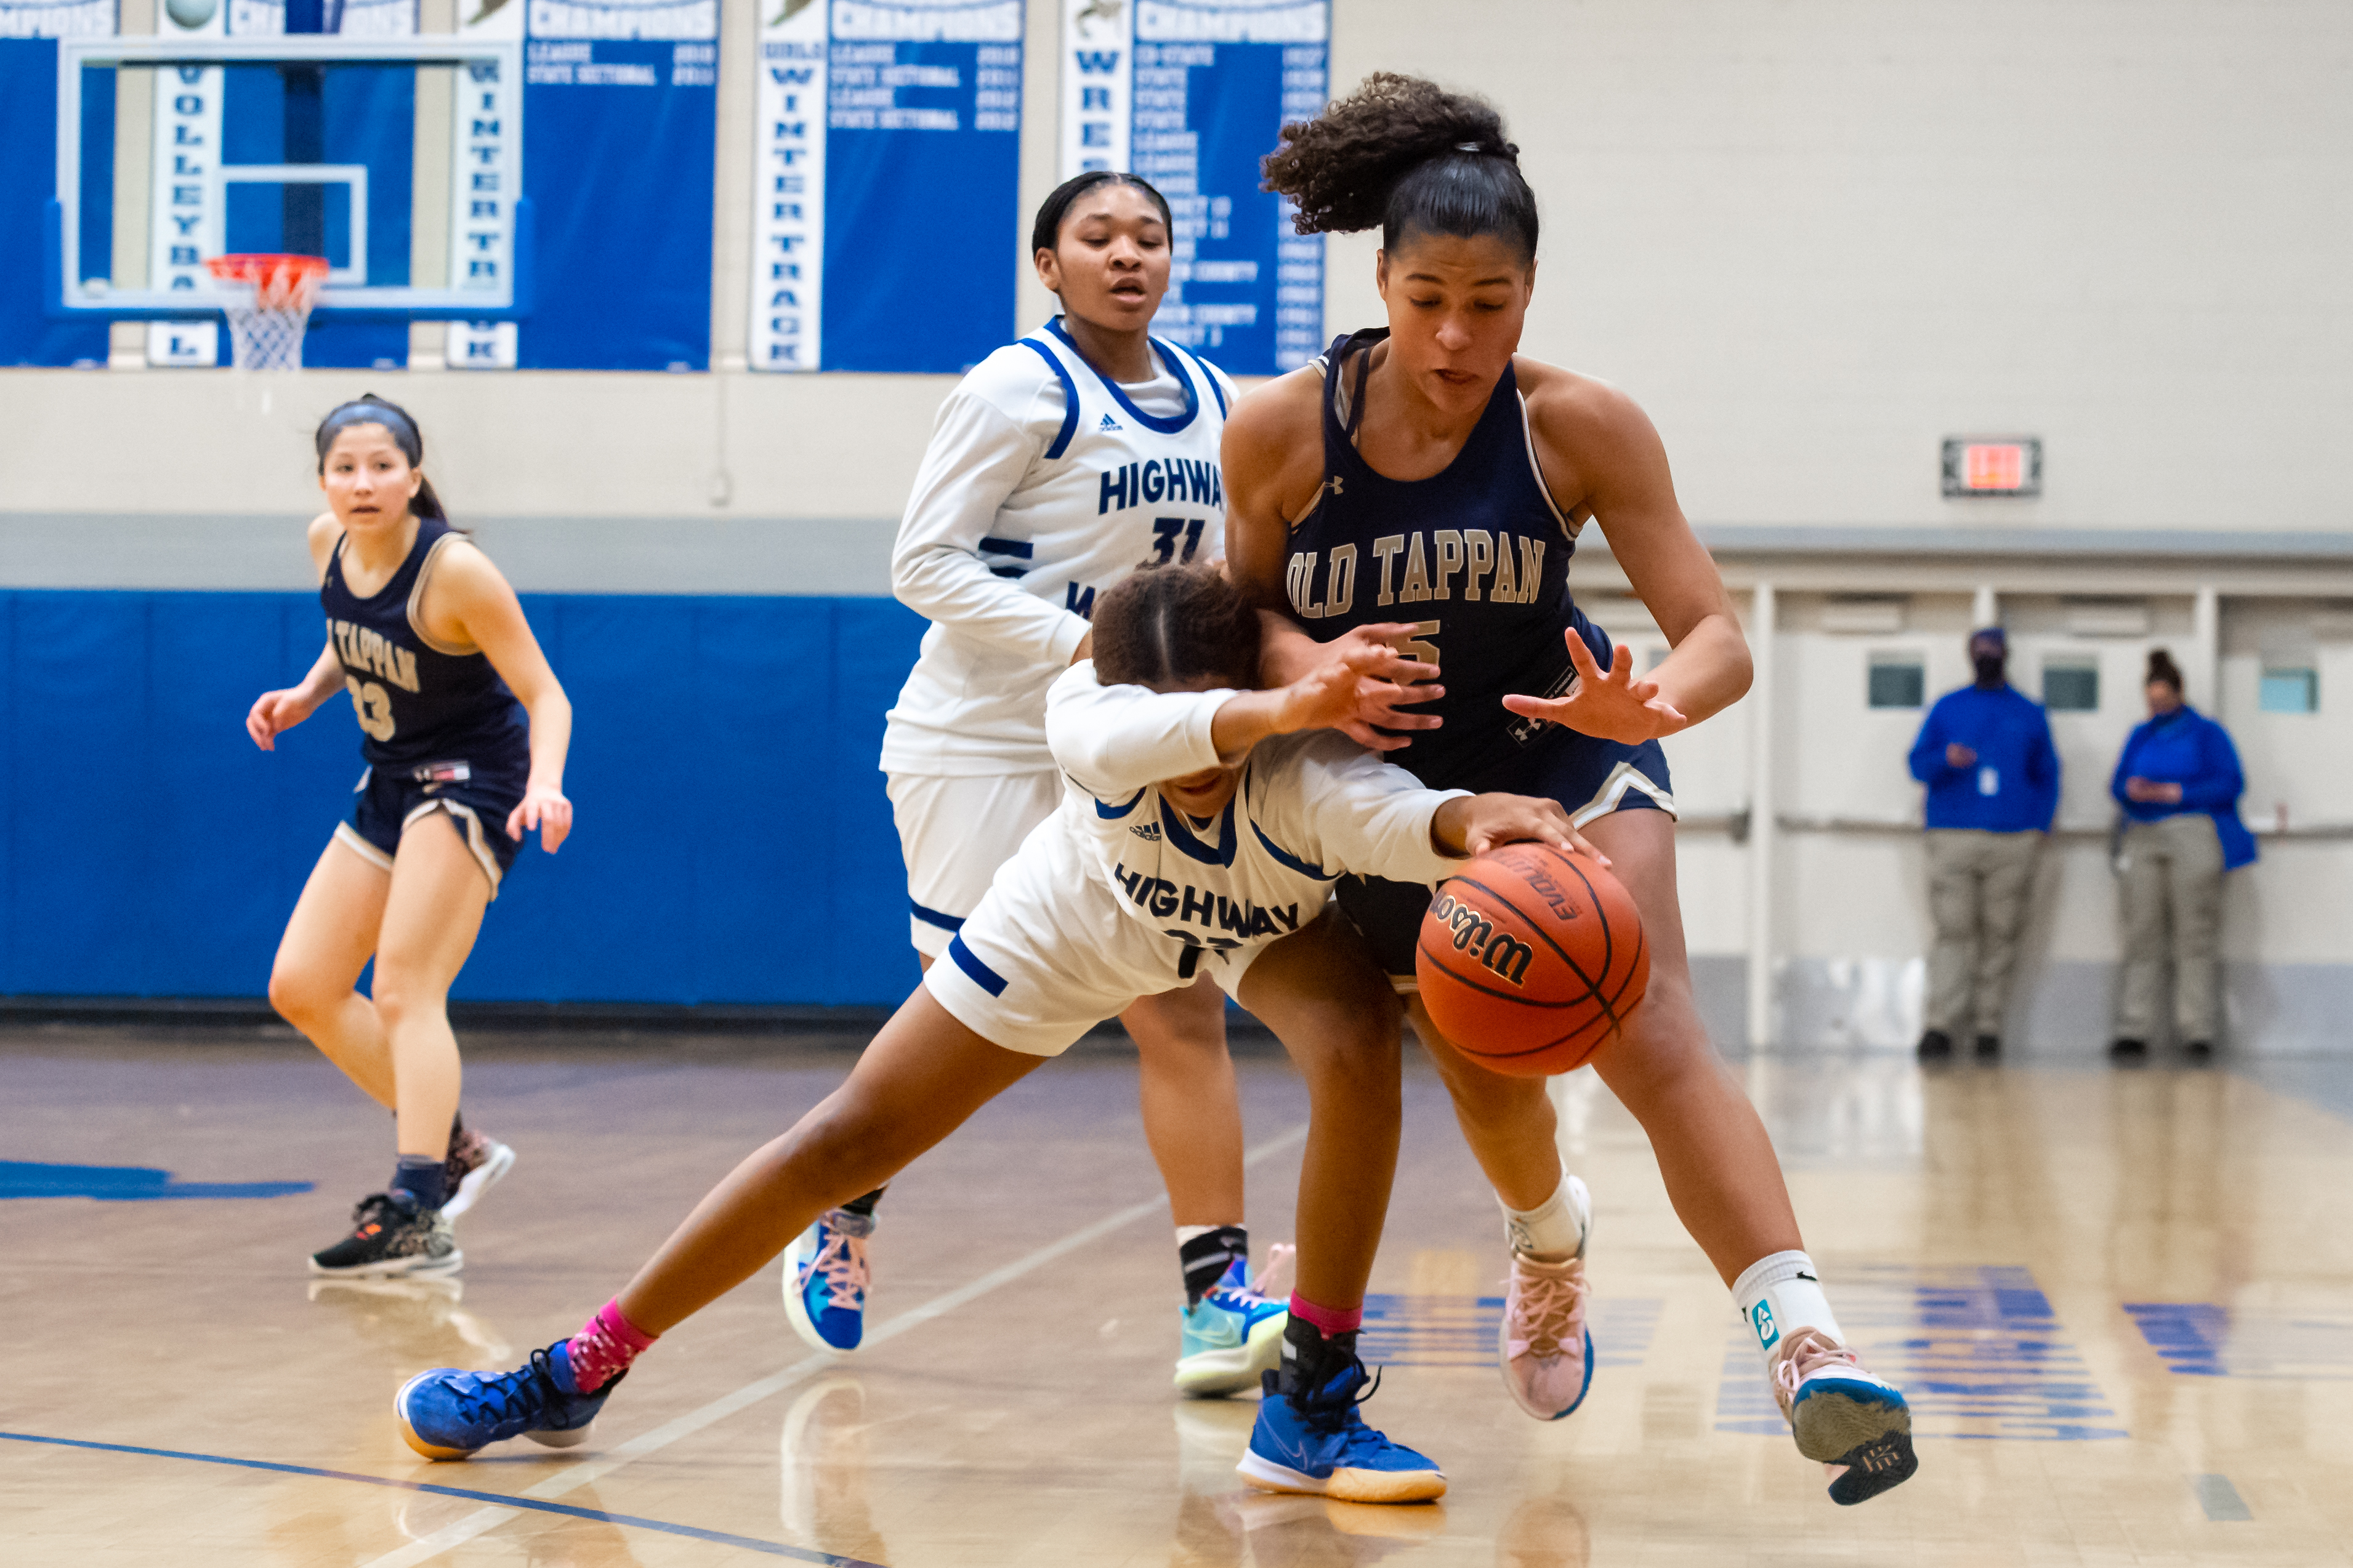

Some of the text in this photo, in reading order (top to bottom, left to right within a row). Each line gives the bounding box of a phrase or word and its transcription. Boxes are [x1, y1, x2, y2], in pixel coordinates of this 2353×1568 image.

[530, 2, 715, 38] CHAMPIONS
[833, 2, 1020, 41] CHAMPIONS
[1137, 2, 1326, 41] CHAMPIONS
[528, 43, 592, 62] LEAGUE
[831, 45, 896, 64] LEAGUE
[528, 65, 572, 84] STATE
[577, 65, 656, 86] SECTIONAL
[831, 66, 876, 85] STATE
[881, 66, 960, 87] SECTIONAL
[831, 88, 895, 107] LEAGUE
[831, 110, 876, 129] STATE
[879, 110, 959, 131] SECTIONAL
[770, 68, 813, 220] WINTER
[769, 235, 805, 361] TRACK
[1137, 517, 1206, 571] 31
[1286, 529, 1546, 619] OLD TAPPAN
[1114, 862, 1300, 939] HIGHWAY
